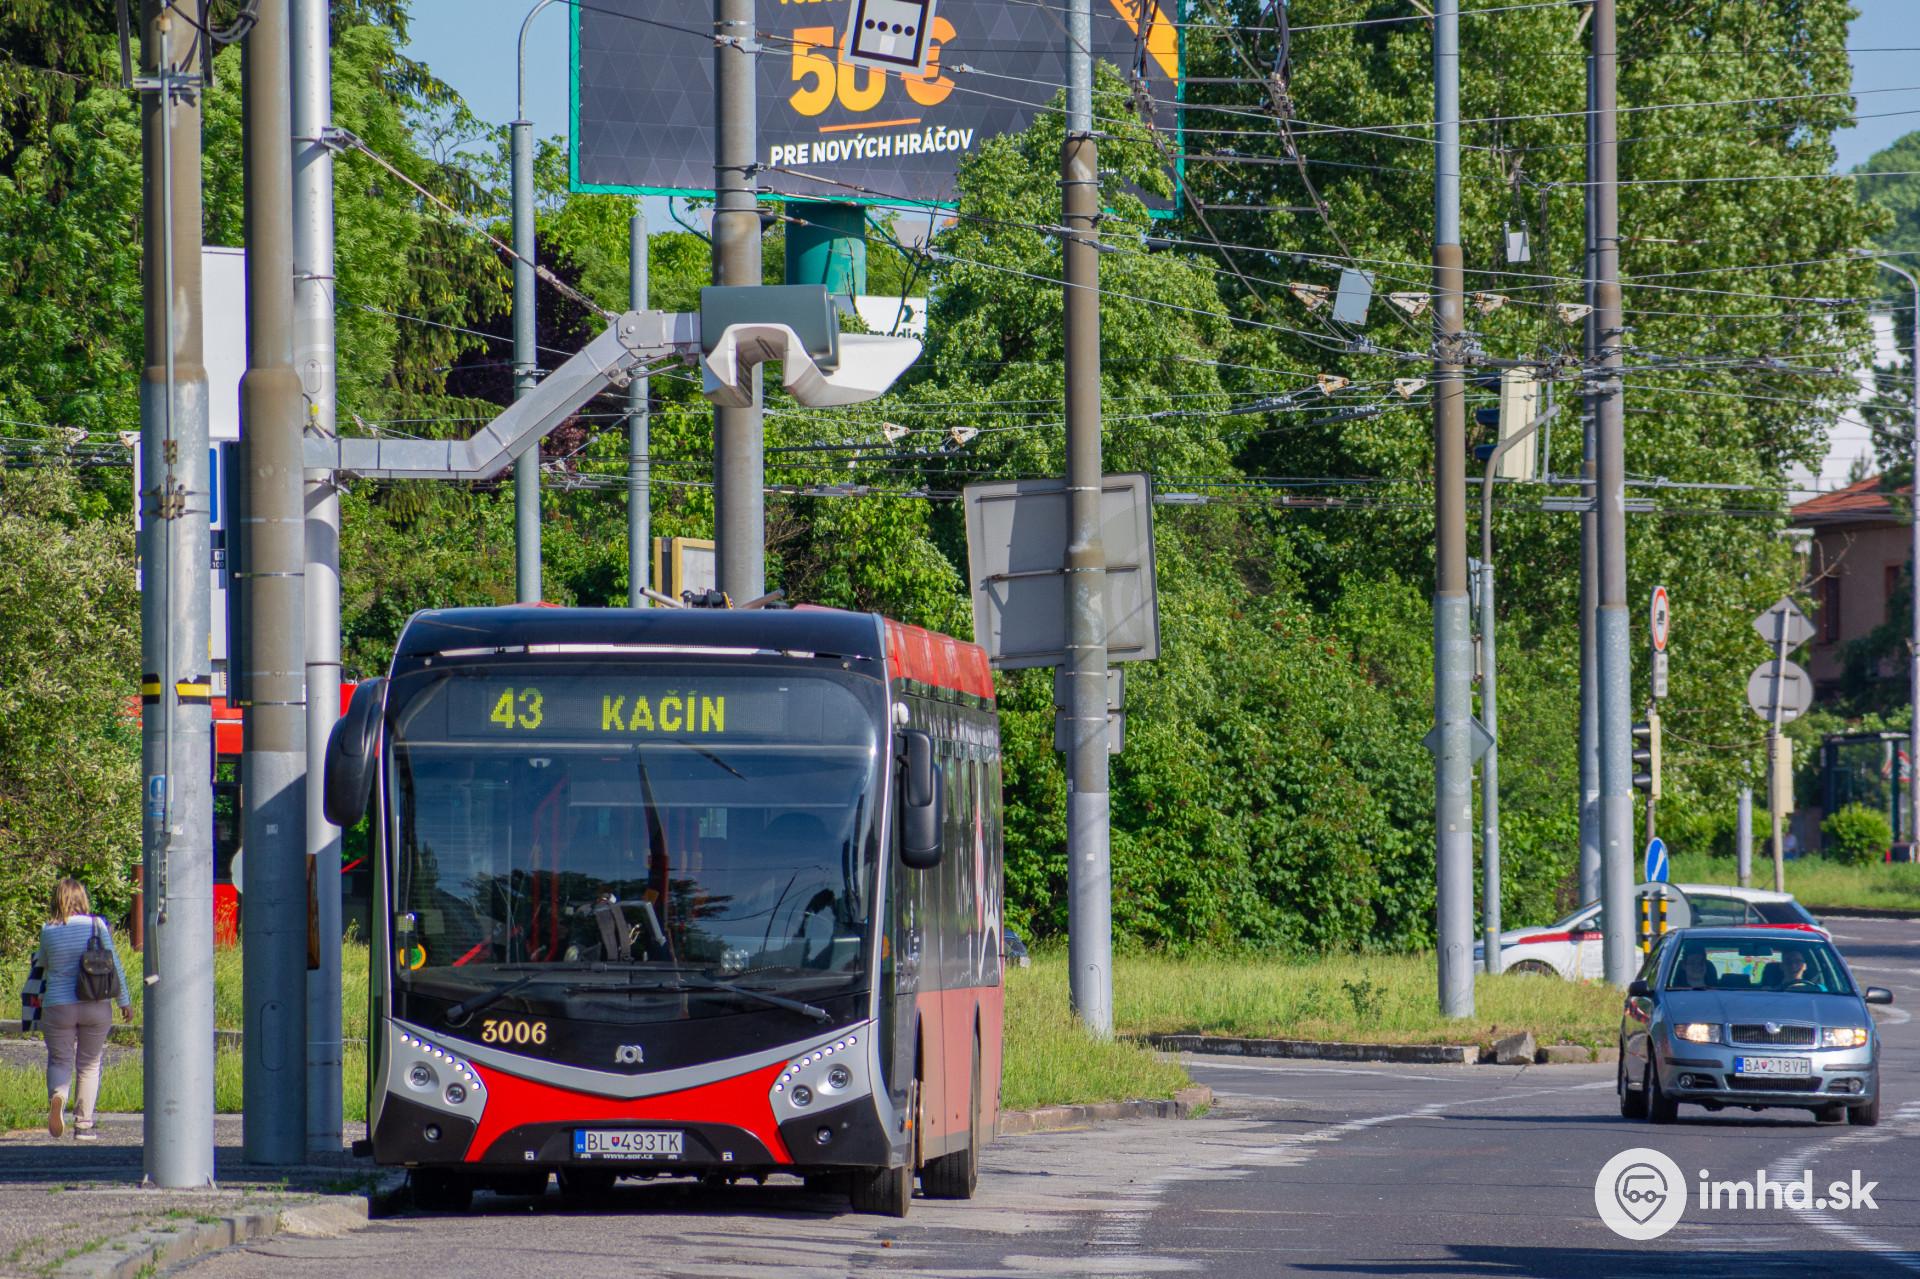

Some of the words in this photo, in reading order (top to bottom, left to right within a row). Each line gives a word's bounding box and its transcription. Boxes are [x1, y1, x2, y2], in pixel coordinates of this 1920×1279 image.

[789, 26, 886, 116] 50
[770, 143, 809, 166] PRE
[812, 133, 891, 163] NOVÝCH
[894, 126, 974, 157] HRÁČOV
[490, 687, 543, 729] 43
[602, 690, 725, 732] KAČÍN
[481, 1019, 547, 1045] 3006
